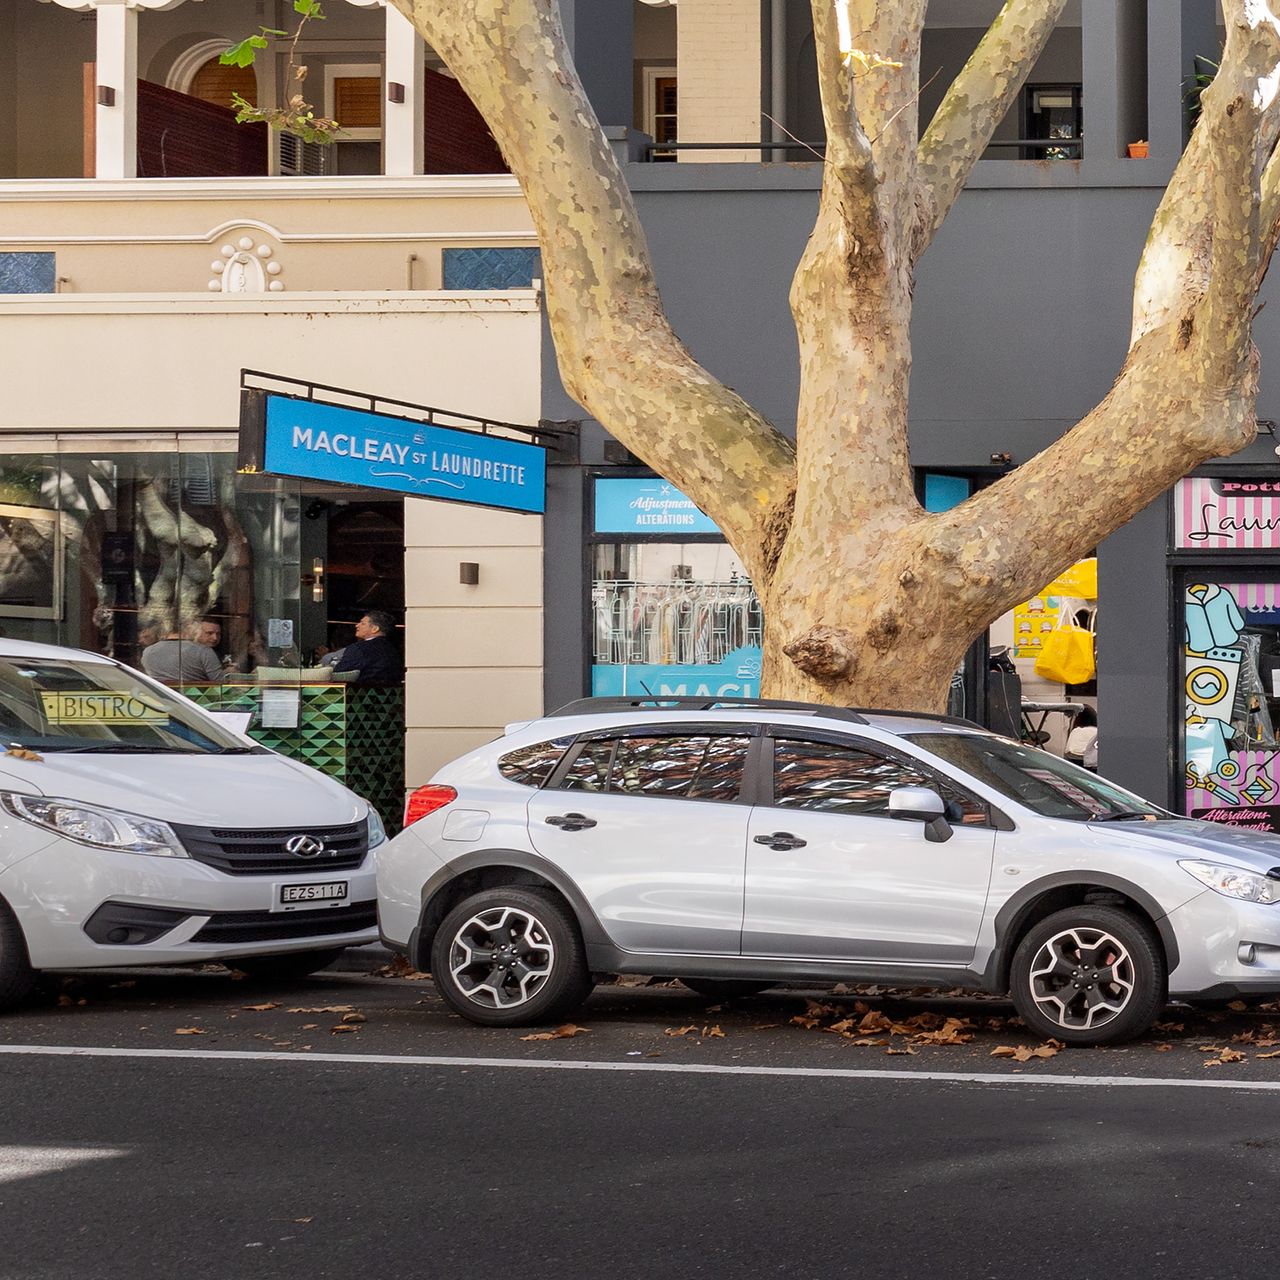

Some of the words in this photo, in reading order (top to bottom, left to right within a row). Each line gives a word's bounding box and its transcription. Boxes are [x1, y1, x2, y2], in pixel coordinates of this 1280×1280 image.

[292, 425, 410, 467] MACLEAY
[412, 452, 428, 465] ST
[431, 451, 526, 486] LAUNDRETTE
[636, 514, 695, 525] ALTERATIONS
[64, 696, 147, 718] BISTRO
[1199, 808, 1271, 821] Alterations
